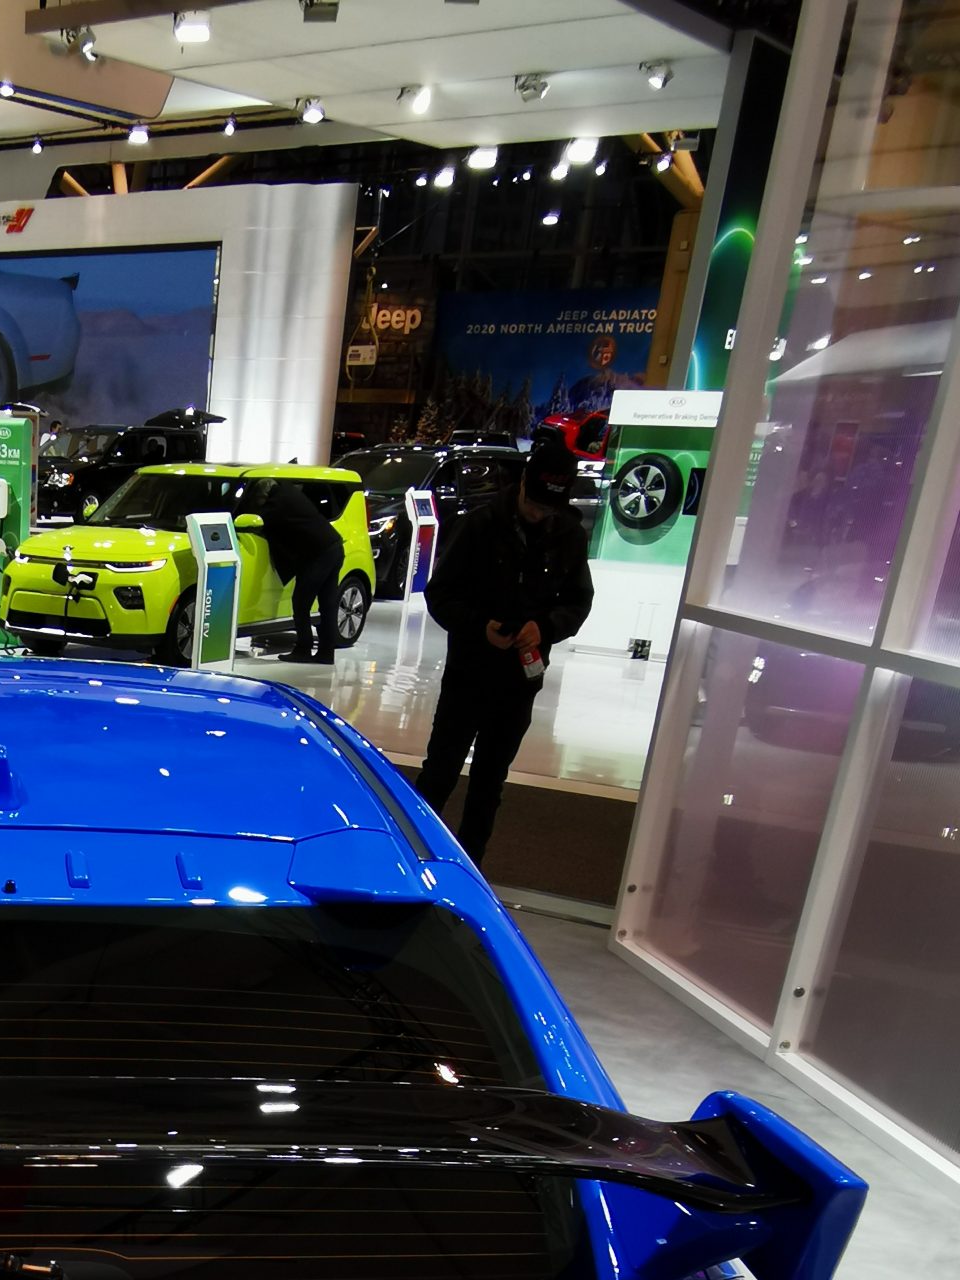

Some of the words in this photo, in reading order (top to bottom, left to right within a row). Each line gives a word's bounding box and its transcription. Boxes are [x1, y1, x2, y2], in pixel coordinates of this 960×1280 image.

[362, 303, 422, 334] Jeep
[557, 310, 588, 321] JEEP
[593, 309, 658, 320] GLADIATO
[466, 323, 496, 334] 2020
[500, 323, 543, 334] NORTH
[547, 322, 614, 334] AMERICAN
[619, 322, 655, 333] TRUC
[8, 448, 20, 458] KM
[204, 589, 213, 618] SOUL
[203, 623, 210, 638] EV
